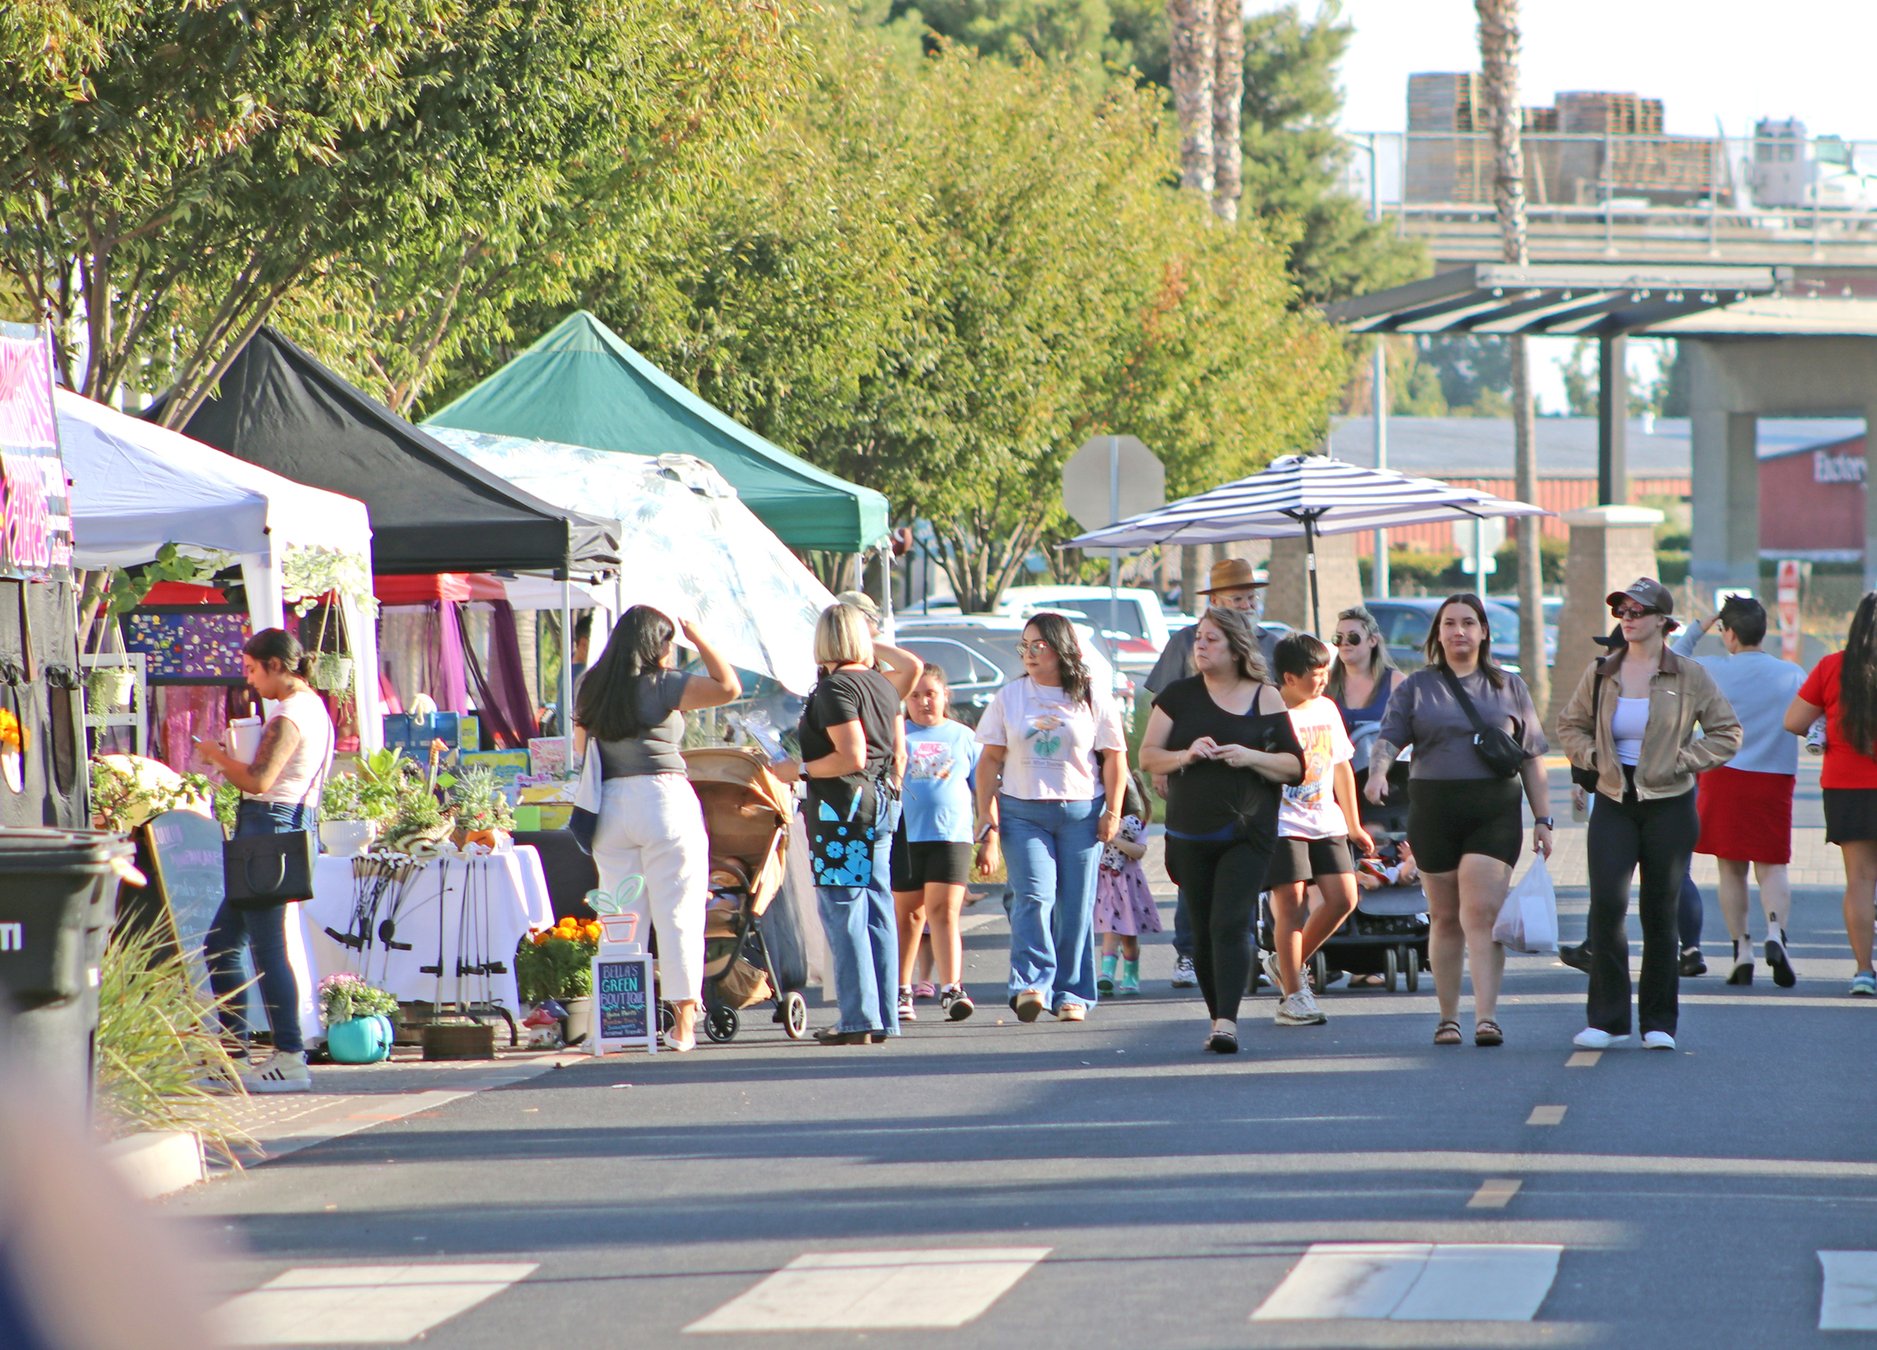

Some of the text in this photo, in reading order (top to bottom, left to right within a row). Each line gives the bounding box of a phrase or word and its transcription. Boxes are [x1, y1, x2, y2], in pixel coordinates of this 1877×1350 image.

[603, 965, 639, 978] BELLA'S
[602, 977, 638, 992] GREEN
[600, 991, 645, 1005] BOUTIQUE
